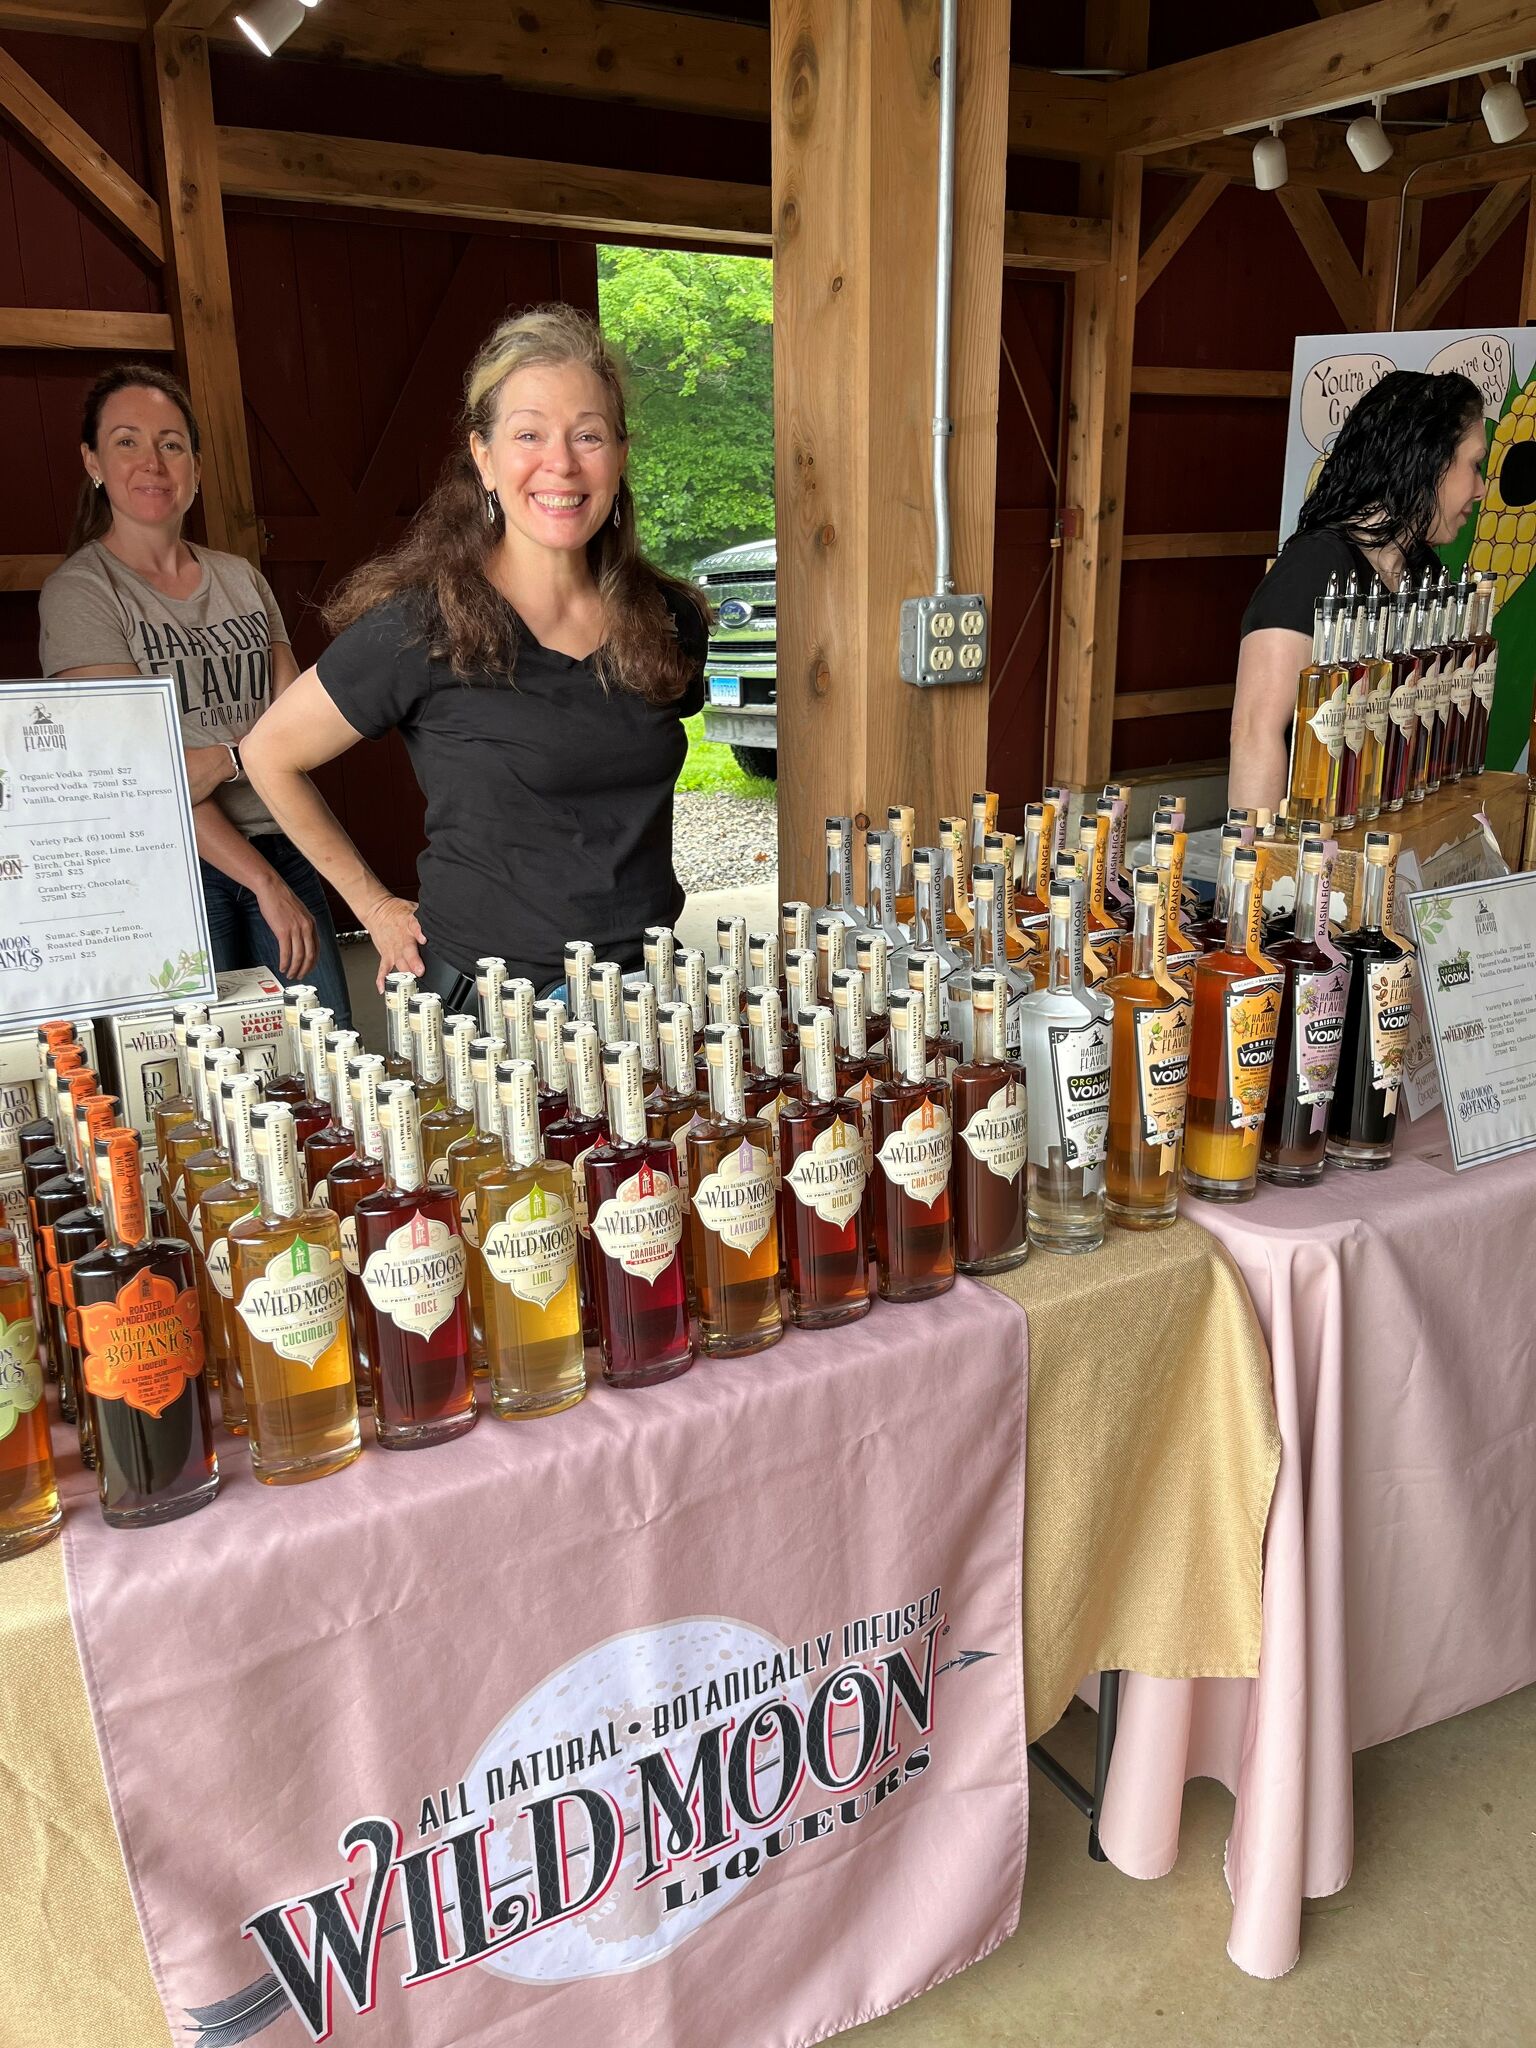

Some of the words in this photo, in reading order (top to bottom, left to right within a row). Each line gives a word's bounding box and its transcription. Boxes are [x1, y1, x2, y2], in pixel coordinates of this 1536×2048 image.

[1482, 341, 1503, 372] So
[1314, 366, 1364, 397] You're
[150, 649, 272, 714] LAVO
[200, 702, 257, 727] COMPANY
[22, 724, 65, 736] HARTFORD
[24, 734, 67, 752] FLAVOR
[19, 772, 54, 782] Organic
[56, 771, 83, 780] Vodka
[87, 768, 114, 777] 750ml
[117, 767, 132, 775] $27
[21, 783, 59, 793] Flavored
[61, 781, 88, 791] Vodka
[92, 779, 119, 788] 750ml
[93, 790, 118, 800] Raisin
[137, 787, 173, 798] Espresso
[29, 836, 62, 848] Variety
[63, 835, 83, 844] Pack
[101, 832, 126, 841] 100ml
[1112, 832, 1120, 850] FIG
[63, 858, 85, 868] Chai
[86, 856, 111, 867] Spice
[884, 848, 892, 879] MOON
[1039, 847, 1050, 887] ORANGE
[1110, 850, 1118, 883] RAISIN
[35, 870, 63, 880] 375ml
[87, 878, 130, 889] Chocolate
[933, 867, 942, 900] MOON
[957, 855, 966, 899] VANILLA
[1093, 858, 1105, 903] ORANGE
[41, 892, 67, 903] 375ml
[885, 887, 893, 913] SPIRIT
[1007, 874, 1015, 920] VANILLA
[1169, 875, 1181, 921] ORANGE
[1322, 880, 1331, 899] FIG
[1384, 875, 1396, 926] ESPRESSO
[996, 885, 1004, 918] MOON
[936, 907, 944, 936] SPIRIT
[1074, 900, 1083, 938] MOON
[1249, 893, 1262, 943] ORANGE
[1318, 901, 1329, 936] RAISIN
[47, 940, 83, 951] Roasted
[85, 935, 131, 947] Dandelion
[133, 931, 153, 940] Root
[996, 928, 1005, 957] SPIRIT
[1156, 914, 1167, 963] VANILLA
[49, 953, 76, 963] 375ml
[1073, 947, 1082, 977] SPIRIT
[1441, 971, 1470, 985] VODKA
[241, 1016, 283, 1026] VARIETY
[249, 1009, 282, 1018] FLAVOR
[1380, 1014, 1410, 1029] VODK
[242, 1022, 283, 1036] PACK
[130, 1031, 168, 1052] WILD
[1070, 1070, 1110, 1087] ORGANIC
[1070, 1081, 1109, 1099] VODKA
[975, 1119, 1009, 1142] WILD
[124, 1150, 137, 1178] CLEAN
[890, 1142, 927, 1164] WILD
[115, 1155, 126, 1177] DRINK
[800, 1162, 838, 1185] WILD
[911, 1176, 928, 1190] CHAI
[928, 1171, 946, 1186] SPICE
[705, 1185, 745, 1209] WILD
[832, 1193, 853, 1209] BIRCH
[604, 1211, 646, 1236] WILD
[730, 1216, 766, 1236] LAVENDER
[493, 1234, 537, 1259] WILD
[540, 1224, 577, 1253] MOON
[630, 1242, 669, 1260] CRANBERRY
[374, 1263, 420, 1288] WILD
[422, 1252, 465, 1282] MOON
[532, 1269, 553, 1286] LIME
[252, 1291, 301, 1318] WILD
[304, 1274, 346, 1310] MOON
[414, 1298, 438, 1316] ROSE
[116, 1311, 158, 1326] DANDELION
[158, 1305, 175, 1317] ROOT
[129, 1301, 162, 1315] ROASTED
[109, 1325, 145, 1343] WILD
[147, 1316, 183, 1337] MOON
[282, 1321, 334, 1347] CUCUMBER
[104, 1327, 193, 1368] BOTANICS
[138, 1359, 168, 1372] LIQUEUR
[418, 1783, 475, 1836] ALL
[486, 1721, 623, 1806] NATURAL
[651, 1635, 832, 1740] BOTANICALLY
[842, 1586, 941, 1658] INFUSED
[242, 1787, 625, 2044] WILD
[633, 1612, 948, 1890] MOON
[660, 1743, 931, 1914] LIQUEURS
